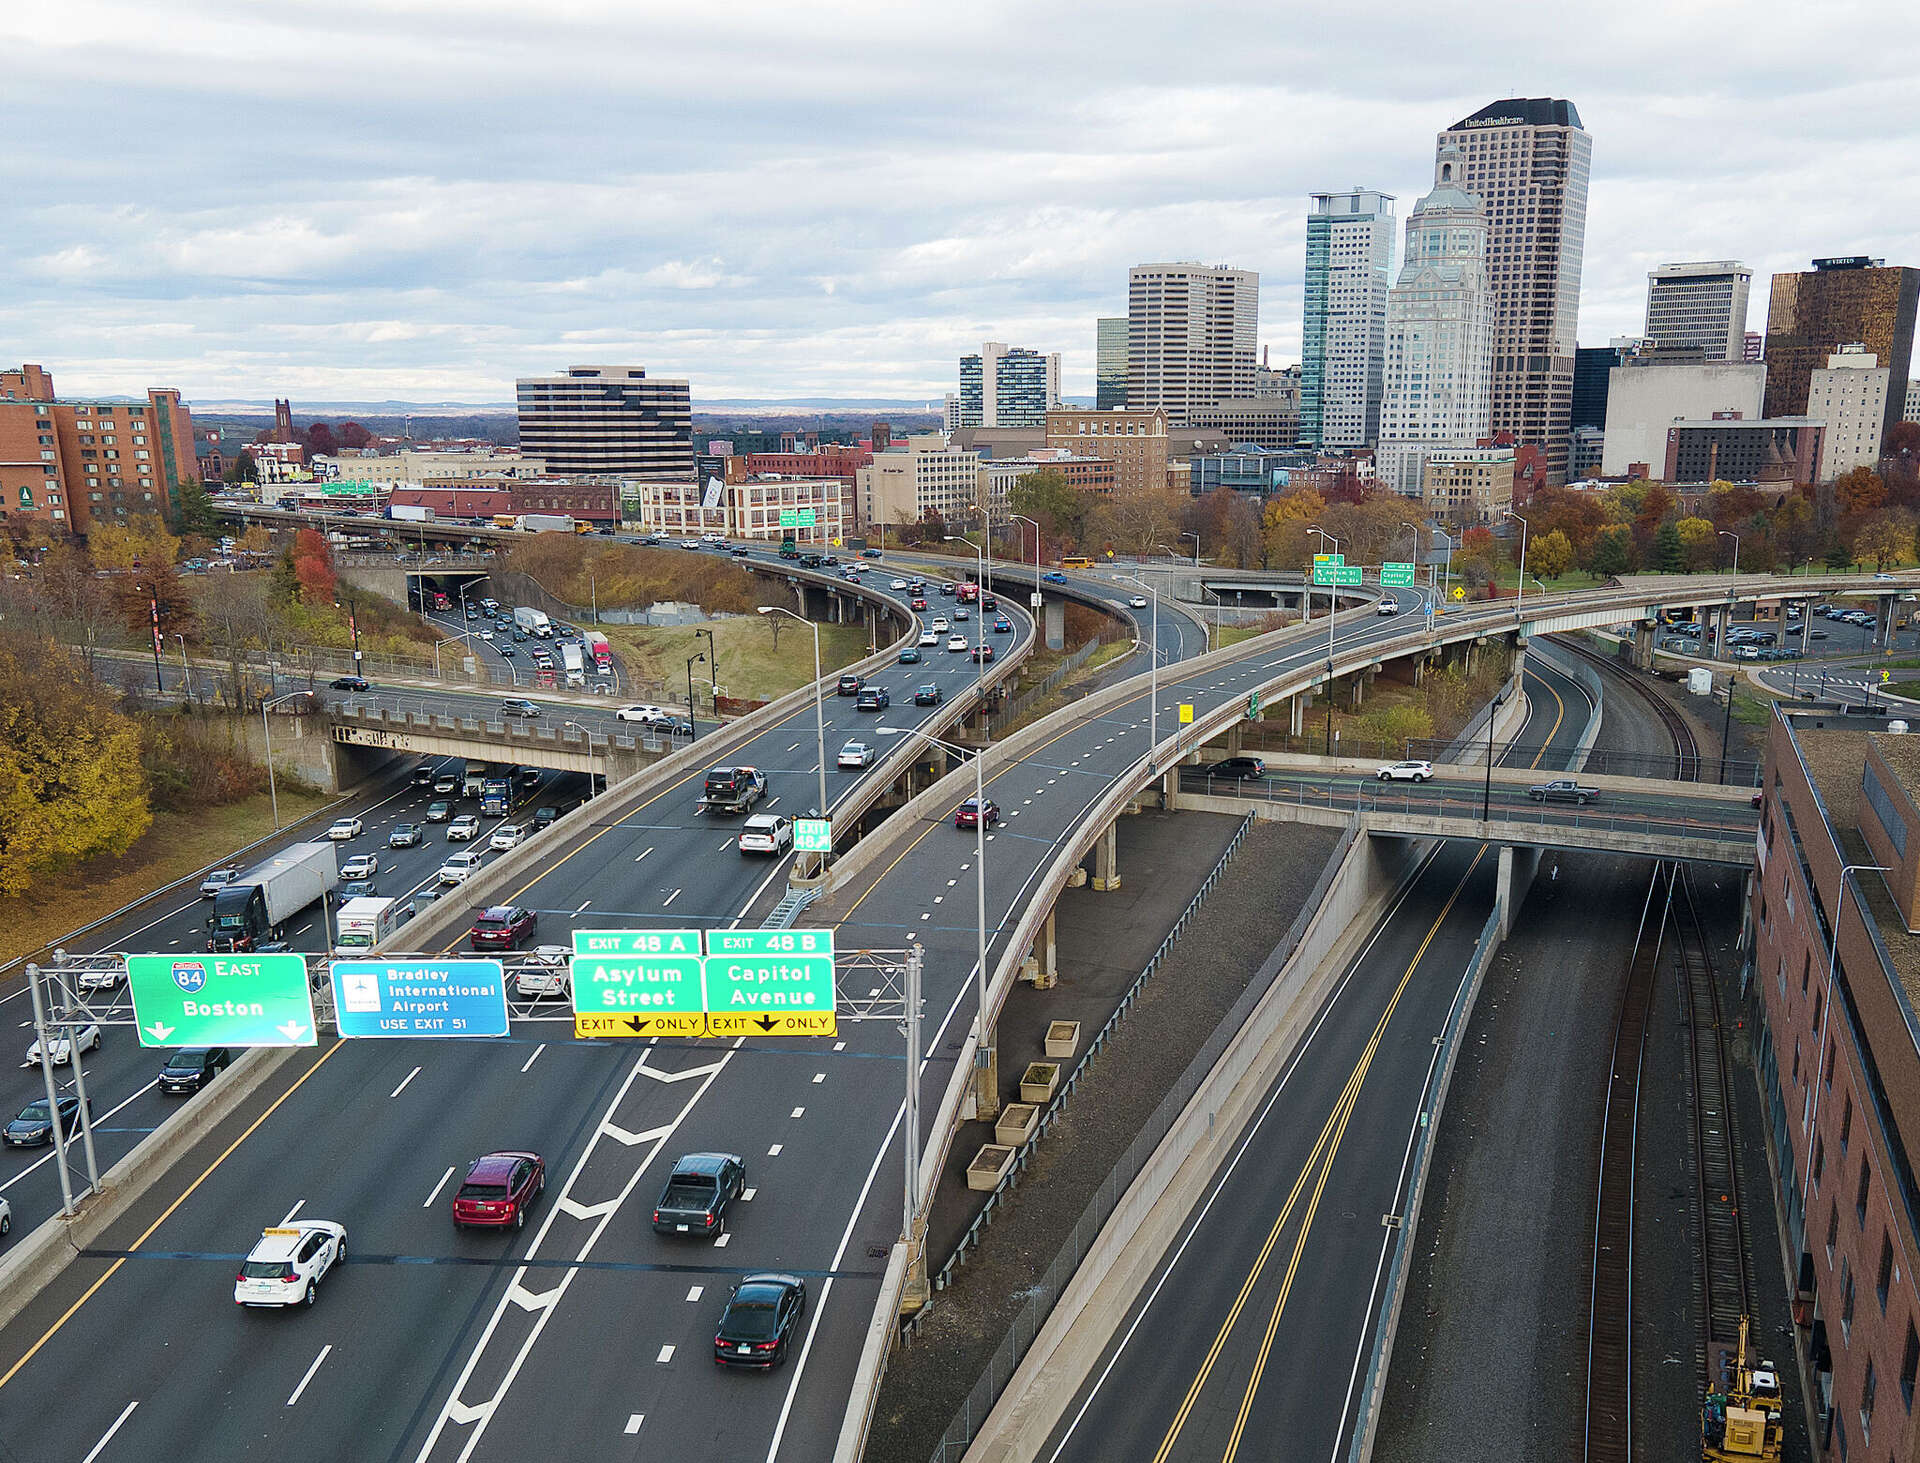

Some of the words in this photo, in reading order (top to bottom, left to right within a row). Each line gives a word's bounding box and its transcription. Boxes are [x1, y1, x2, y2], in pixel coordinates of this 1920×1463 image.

[798, 822, 826, 834] EXIT
[796, 835, 815, 848] 48
[589, 938, 621, 950] EXIT
[633, 936, 660, 951] 48
[670, 936, 686, 951] A
[723, 937, 754, 949] EXIT
[766, 935, 794, 951] 48
[802, 935, 816, 951] B
[214, 961, 261, 976] EAST
[386, 969, 449, 982] Bradley
[593, 965, 682, 986] Asylum
[728, 965, 810, 984] Capitol
[177, 971, 202, 986] 84
[389, 985, 495, 997] International
[602, 989, 675, 1006] Street
[730, 989, 816, 1005] Avenue
[183, 1000, 263, 1016] Boston
[392, 1001, 449, 1013] Airport
[380, 1019, 408, 1029] USE
[415, 1019, 444, 1029] EXIT
[453, 1018, 467, 1029] 51
[581, 1019, 615, 1030] EXIT
[656, 1019, 698, 1030] ONLY
[713, 1018, 747, 1029] EXIT
[786, 1017, 829, 1029] ONLY
